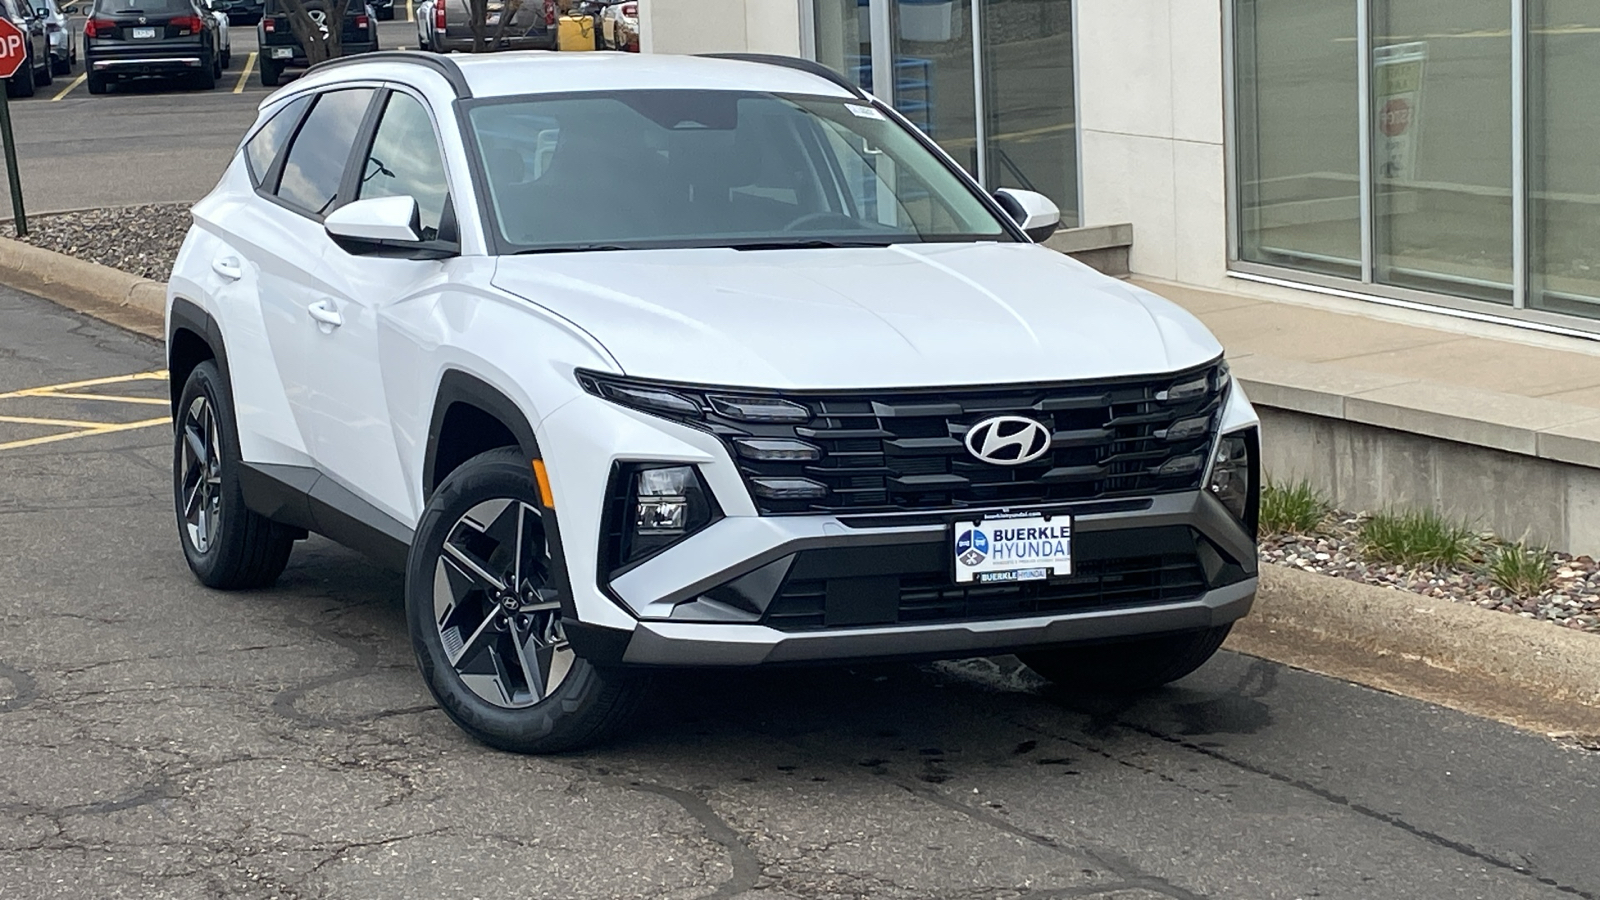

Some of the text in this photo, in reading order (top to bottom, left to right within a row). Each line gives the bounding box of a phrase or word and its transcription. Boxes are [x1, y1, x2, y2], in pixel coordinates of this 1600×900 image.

[993, 526, 1070, 542] BUERKLE
[992, 540, 1070, 559] HYUNDAI
[982, 572, 1017, 582] BUERKLE
[1018, 570, 1045, 579] HYUNDAI
